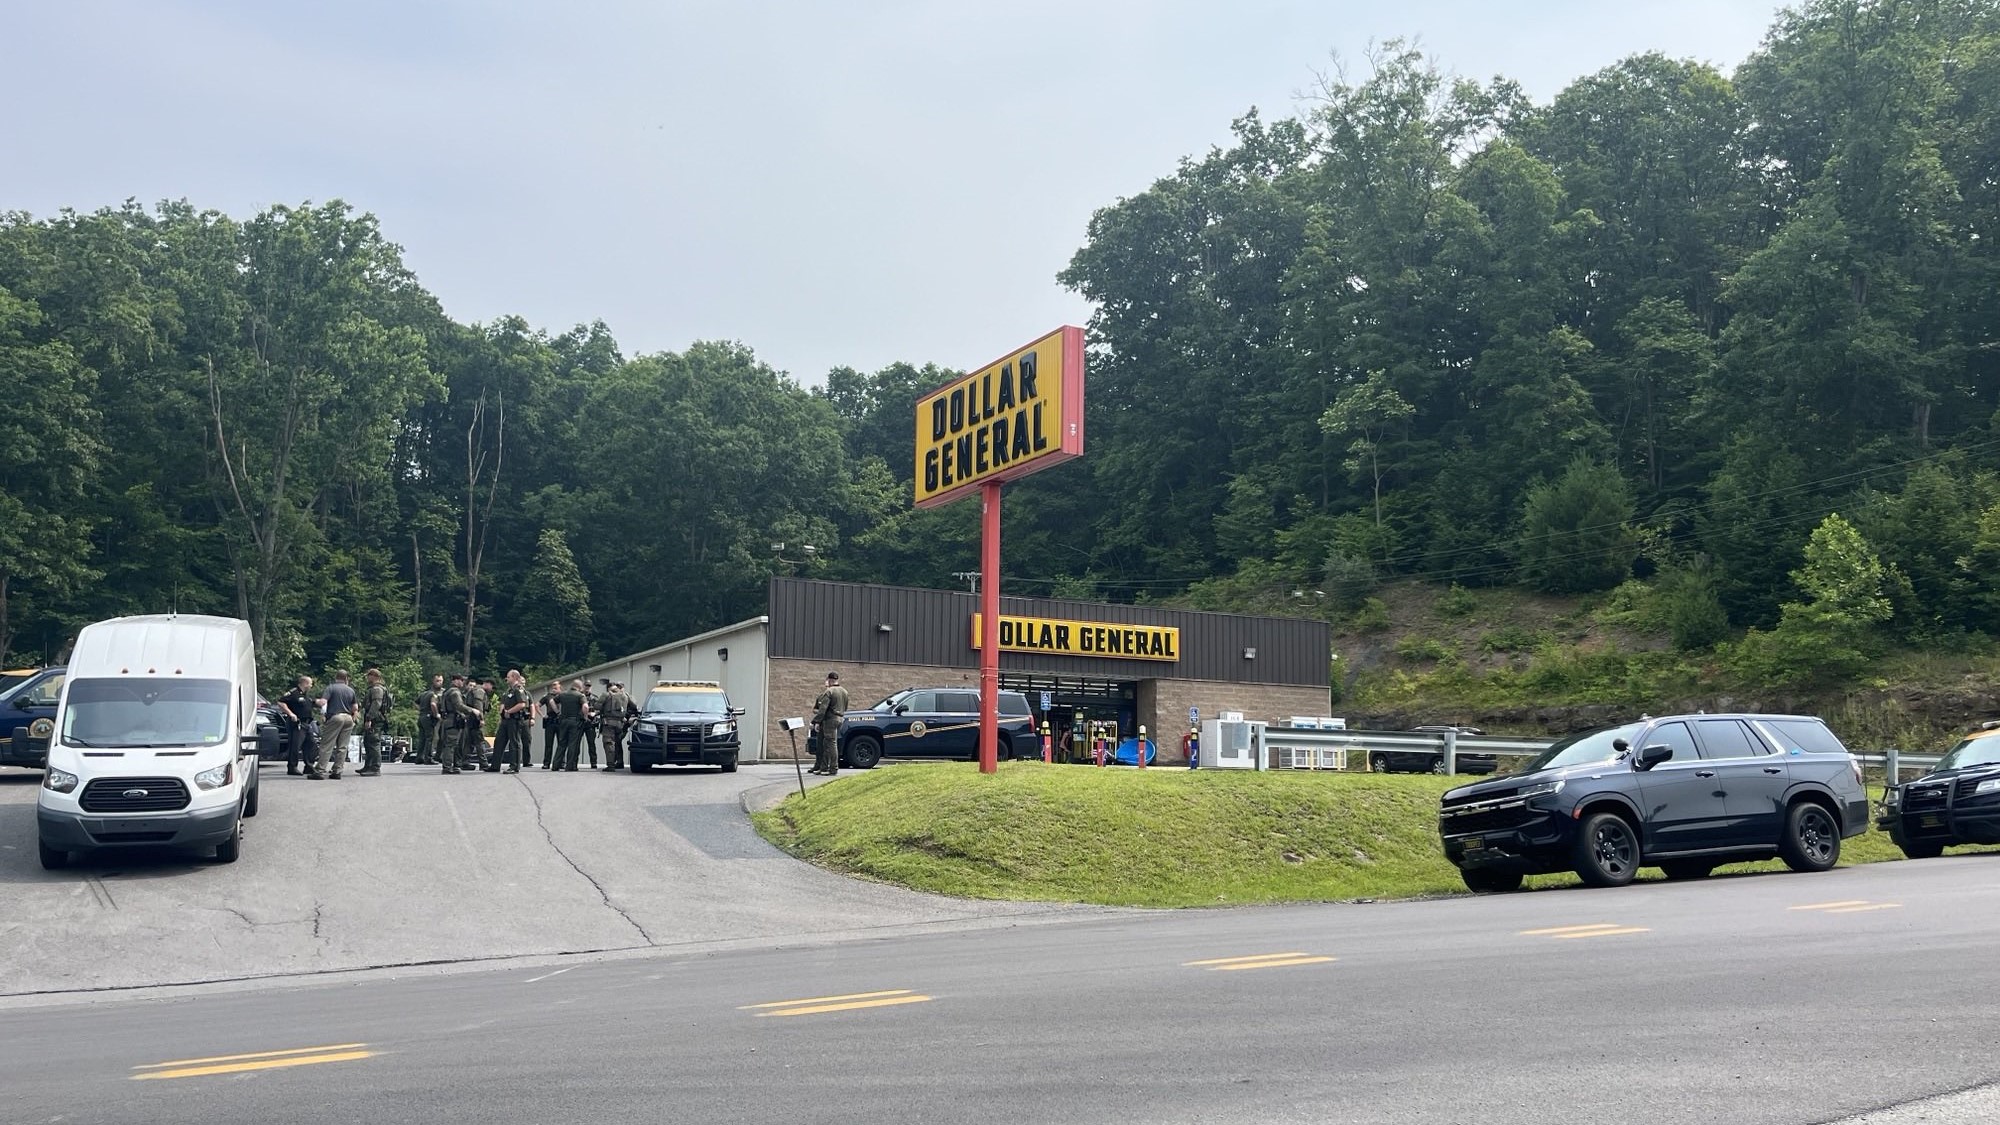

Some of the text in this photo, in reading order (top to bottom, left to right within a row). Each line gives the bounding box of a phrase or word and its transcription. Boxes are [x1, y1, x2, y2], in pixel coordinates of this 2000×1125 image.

[932, 351, 1038, 442] DOLLAR
[925, 402, 1047, 493] GENERAL
[999, 621, 1175, 656] OLLAR GENERAL
